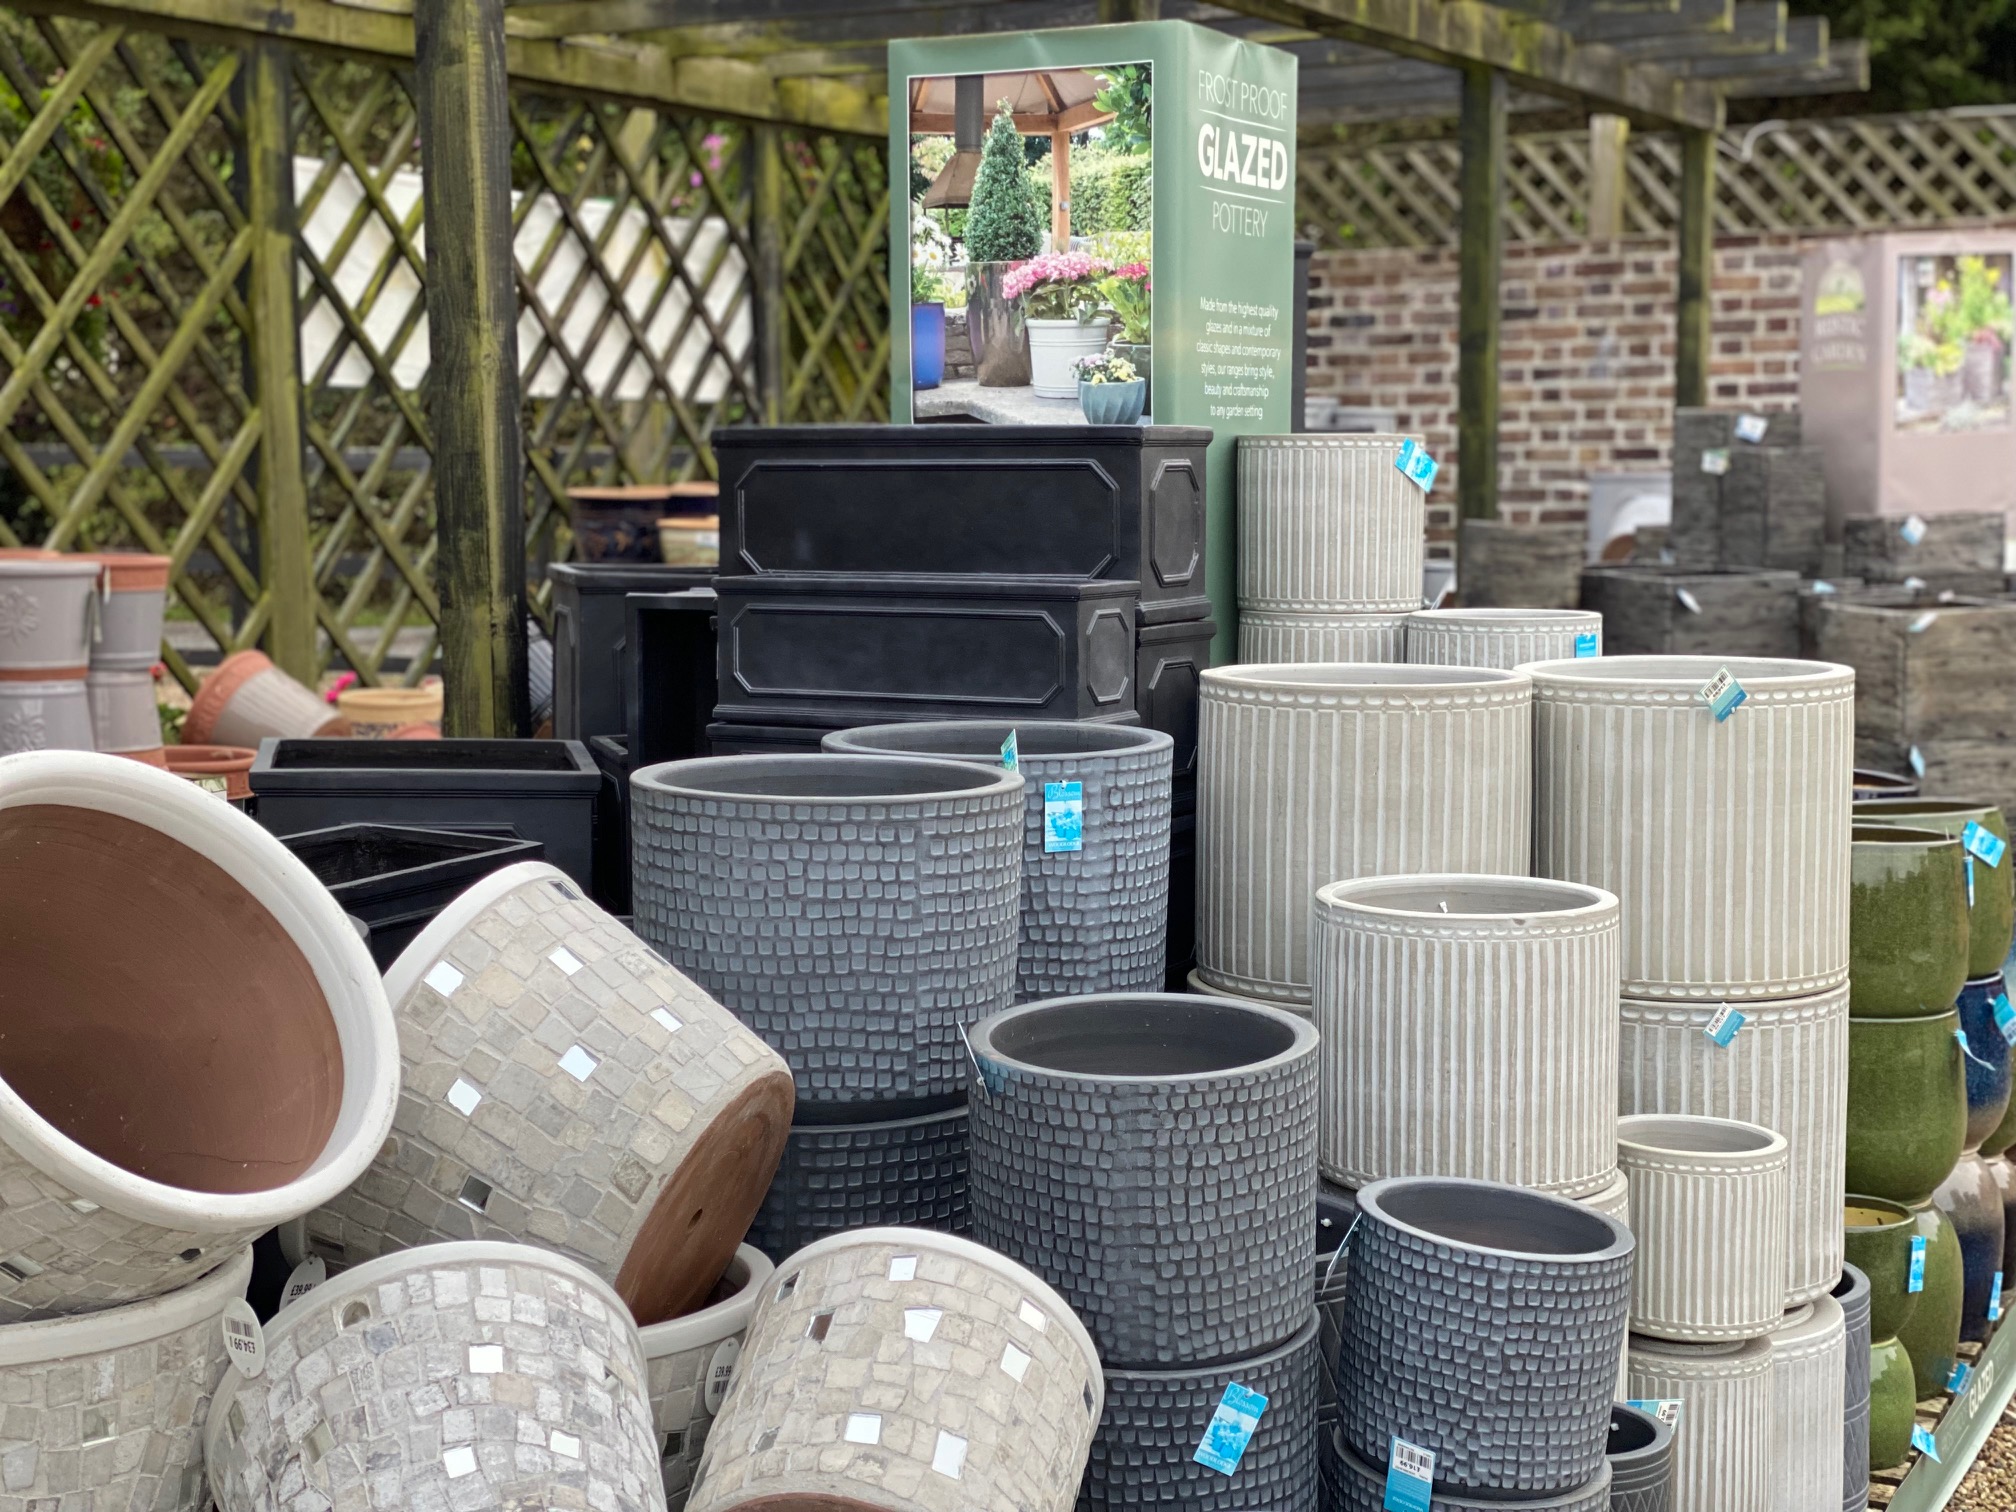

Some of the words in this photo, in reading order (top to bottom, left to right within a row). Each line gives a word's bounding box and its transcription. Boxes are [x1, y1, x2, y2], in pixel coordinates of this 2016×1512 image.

[1198, 69, 1238, 109] FROST
[1241, 82, 1288, 120] PROOF
[1197, 123, 1288, 190] GLAZED
[1213, 201, 1268, 238] POTTERY
[1200, 297, 1216, 312] Made
[1216, 298, 1228, 313] from
[1228, 300, 1237, 314] the
[1238, 301, 1258, 318] highest
[1258, 304, 1279, 320] quality
[1205, 319, 1222, 335] glazes
[1222, 321, 1232, 334] and
[1243, 323, 1263, 336] mixture
[1264, 323, 1272, 337] of
[1196, 339, 1213, 353] classic
[1213, 341, 1231, 357] shapes
[1231, 342, 1241, 355] and
[1242, 344, 1281, 360] contemporary
[1217, 364, 1225, 375] our
[1226, 365, 1243, 379] ranges
[1244, 363, 1258, 380] bring
[1204, 381, 1222, 398] beauty
[1222, 382, 1232, 396] and
[1233, 382, 1269, 400] craftsmanship
[1210, 404, 1216, 416] to
[1216, 406, 1225, 419] any
[1244, 405, 1263, 420] setting
[1047, 784, 1081, 800] Blossom
[234, 1338, 256, 1354] £34.99
[1222, 1387, 1259, 1413] Blossom
[1399, 1460, 1421, 1473] £16.99
